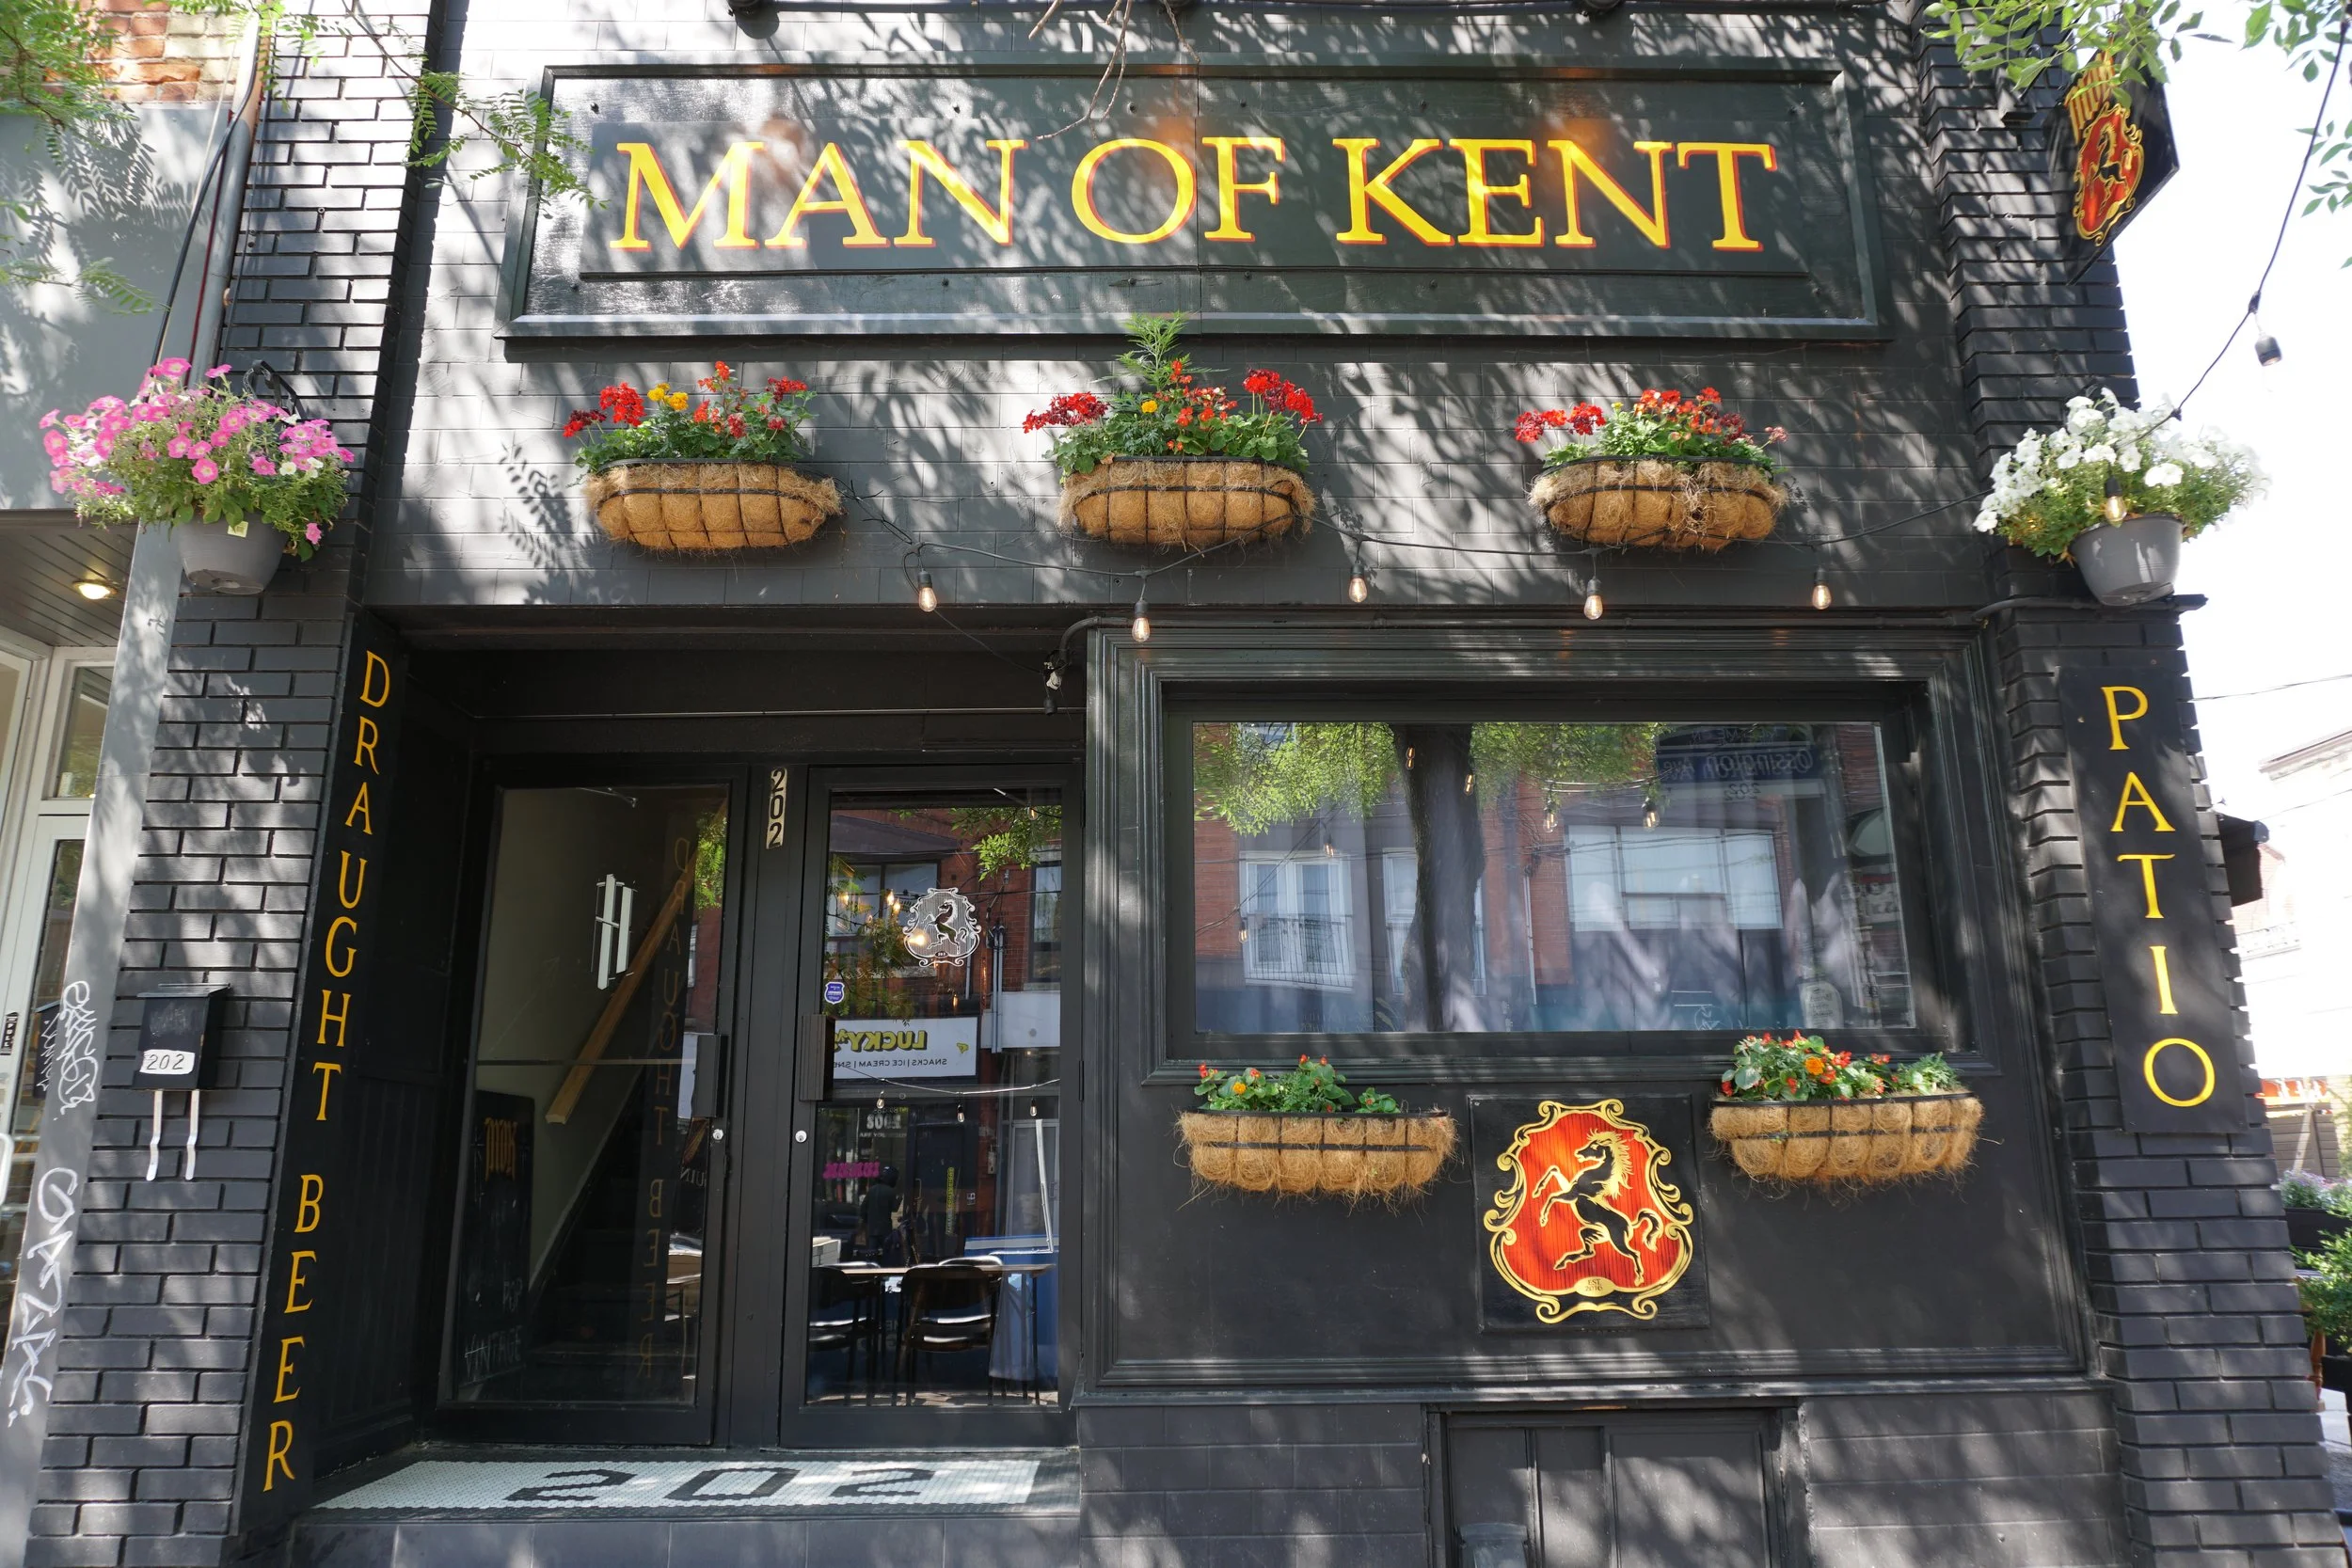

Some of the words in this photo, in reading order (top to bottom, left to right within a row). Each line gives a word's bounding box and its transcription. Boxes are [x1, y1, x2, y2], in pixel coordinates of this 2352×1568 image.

[609, 138, 1025, 251] MAN
[1071, 135, 1285, 246] OF
[1332, 134, 1778, 254] KENT
[768, 767, 787, 848] 202
[313, 649, 390, 1121] DRAUGHT
[2100, 684, 2217, 1108] PATIO
[147, 1053, 184, 1070] 202
[262, 1174, 324, 1491] BEER
[504, 1466, 935, 1502] 202
